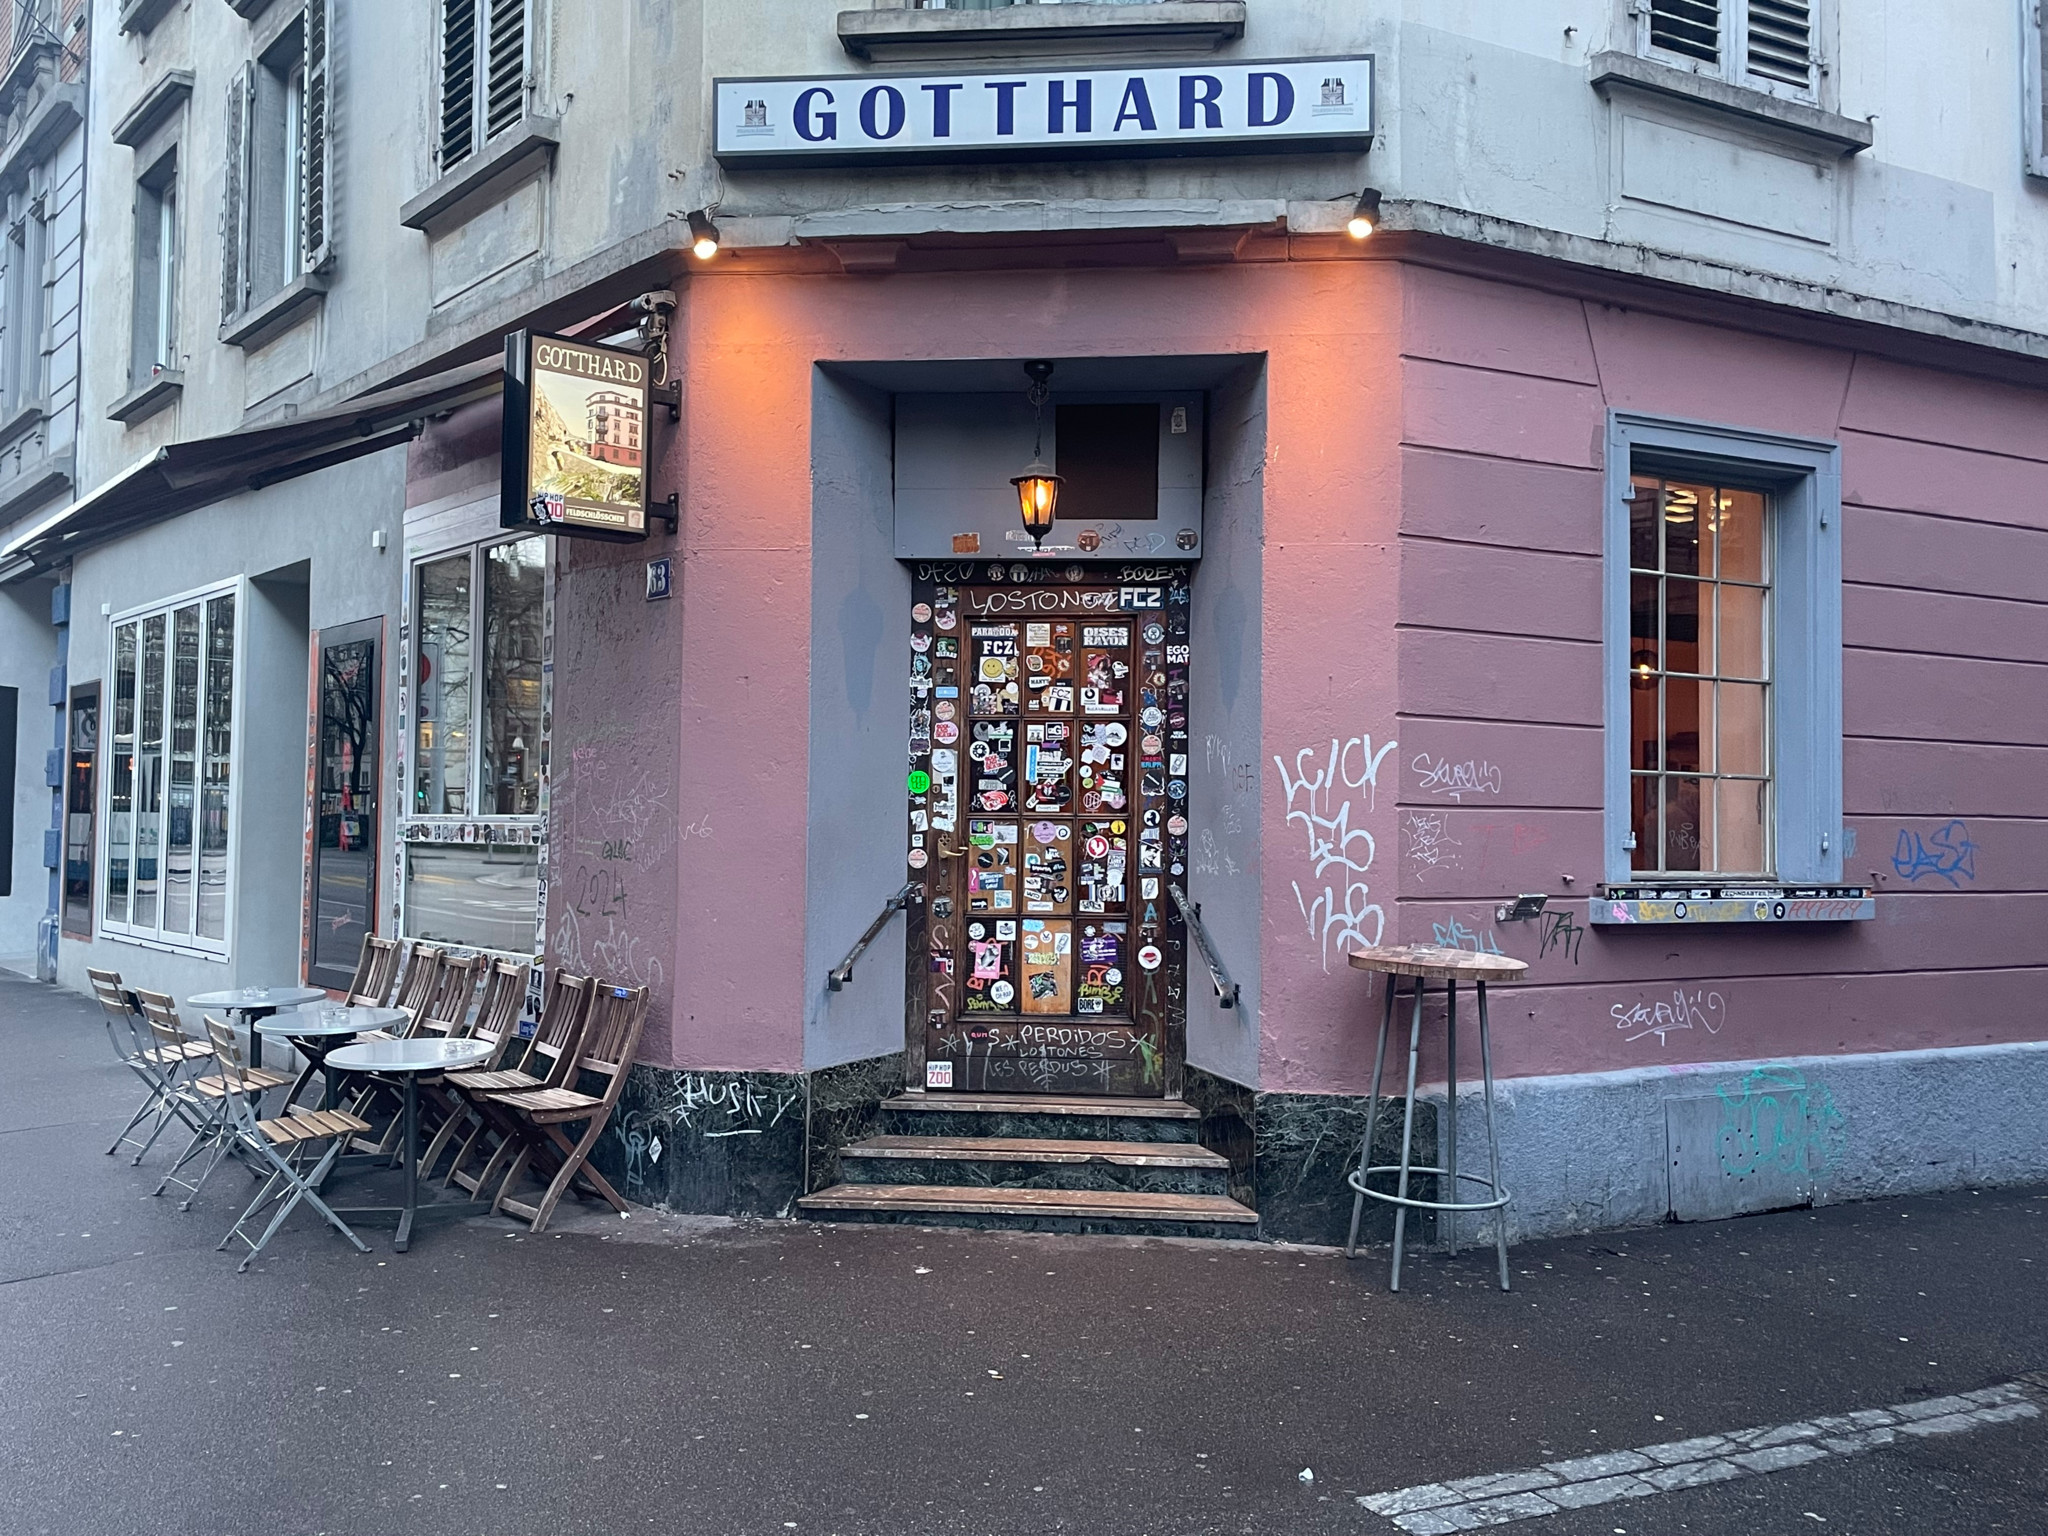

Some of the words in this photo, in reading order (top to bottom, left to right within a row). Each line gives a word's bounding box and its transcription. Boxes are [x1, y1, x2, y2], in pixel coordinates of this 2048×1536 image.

[793, 72, 1295, 142] GOTTHARD
[537, 344, 642, 383] GOTTHARD
[649, 563, 666, 593] 63
[1120, 587, 1161, 607] FCZ
[983, 641, 1013, 655] FCZ
[1166, 645, 1190, 655] EGO
[1166, 655, 1190, 664] MAT
[1051, 687, 1071, 699] FCZ
[928, 1072, 951, 1085] ZOO
